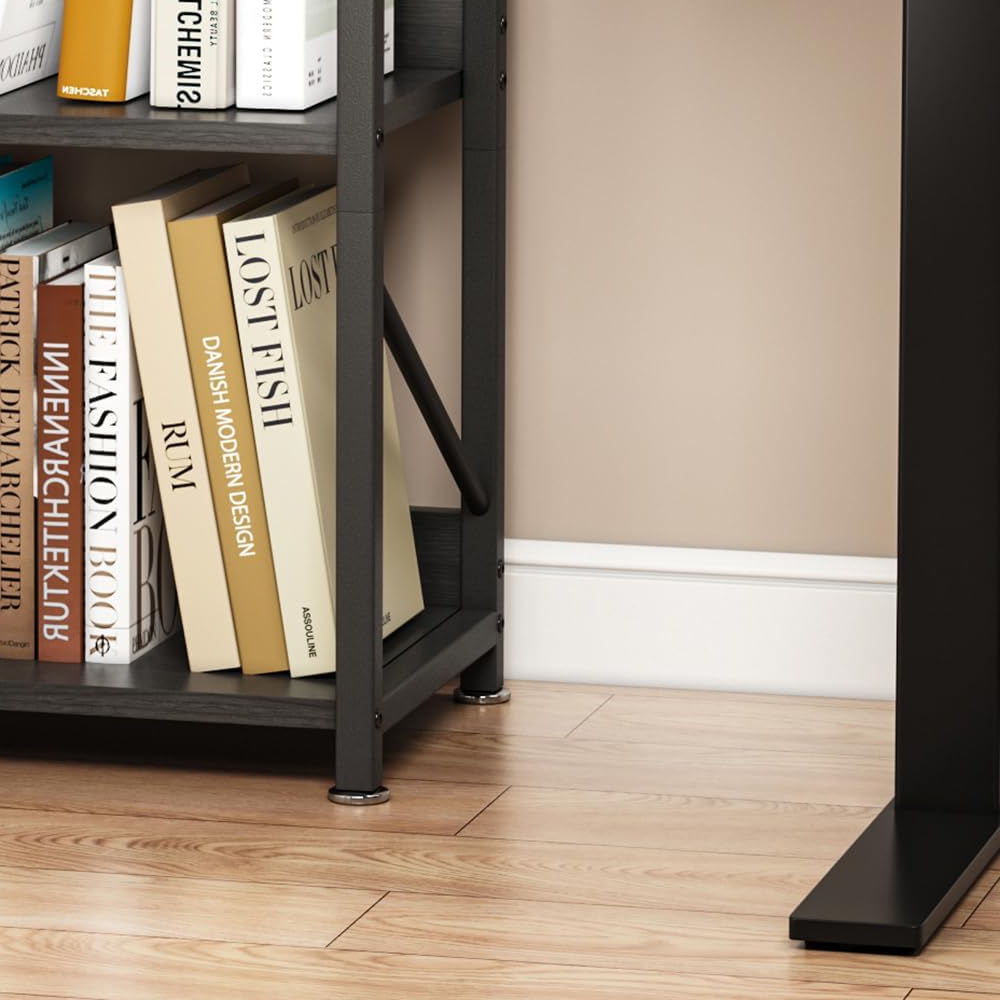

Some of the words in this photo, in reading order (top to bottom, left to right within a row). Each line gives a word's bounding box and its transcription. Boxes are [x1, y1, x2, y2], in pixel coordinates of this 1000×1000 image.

[0, 257, 21, 376] PATRICK
[88, 265, 118, 346] THE
[235, 233, 279, 331] LOST
[288, 249, 331, 311] LOST
[202, 335, 230, 404] DANISH
[251, 343, 293, 428] FISH
[88, 358, 118, 533] FASHION
[161, 420, 197, 491] RUM
[215, 408, 244, 488] MODERN
[0, 387, 22, 612] DEMARCHELIER
[229, 490, 256, 558] DESIGN
[88, 545, 118, 657] BOOK
[302, 606, 318, 658] ASSOULINE
